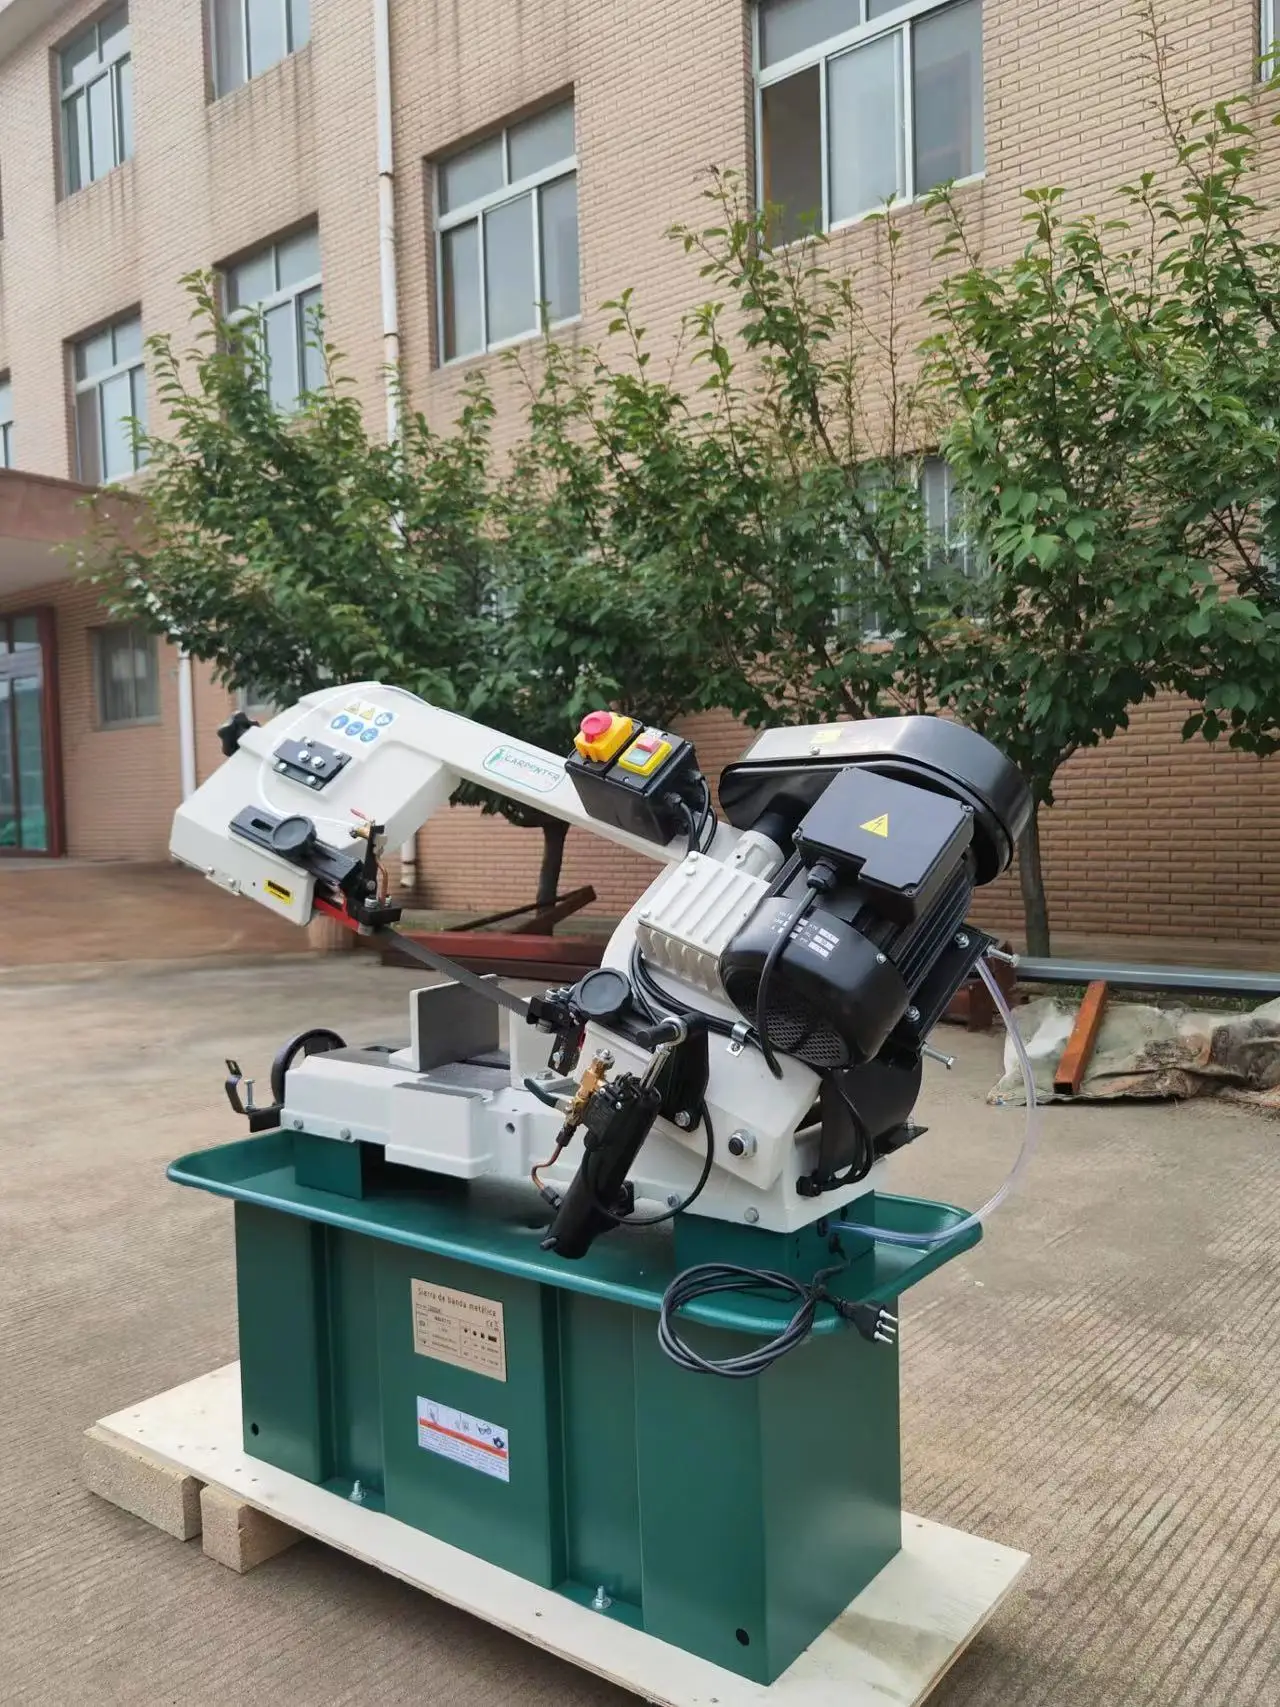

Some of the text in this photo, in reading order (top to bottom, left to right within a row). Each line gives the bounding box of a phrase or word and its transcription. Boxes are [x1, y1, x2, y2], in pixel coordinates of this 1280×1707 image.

[417, 1287, 436, 1299] Sierra
[437, 1293, 446, 1303] de
[447, 1297, 467, 1309] banda
